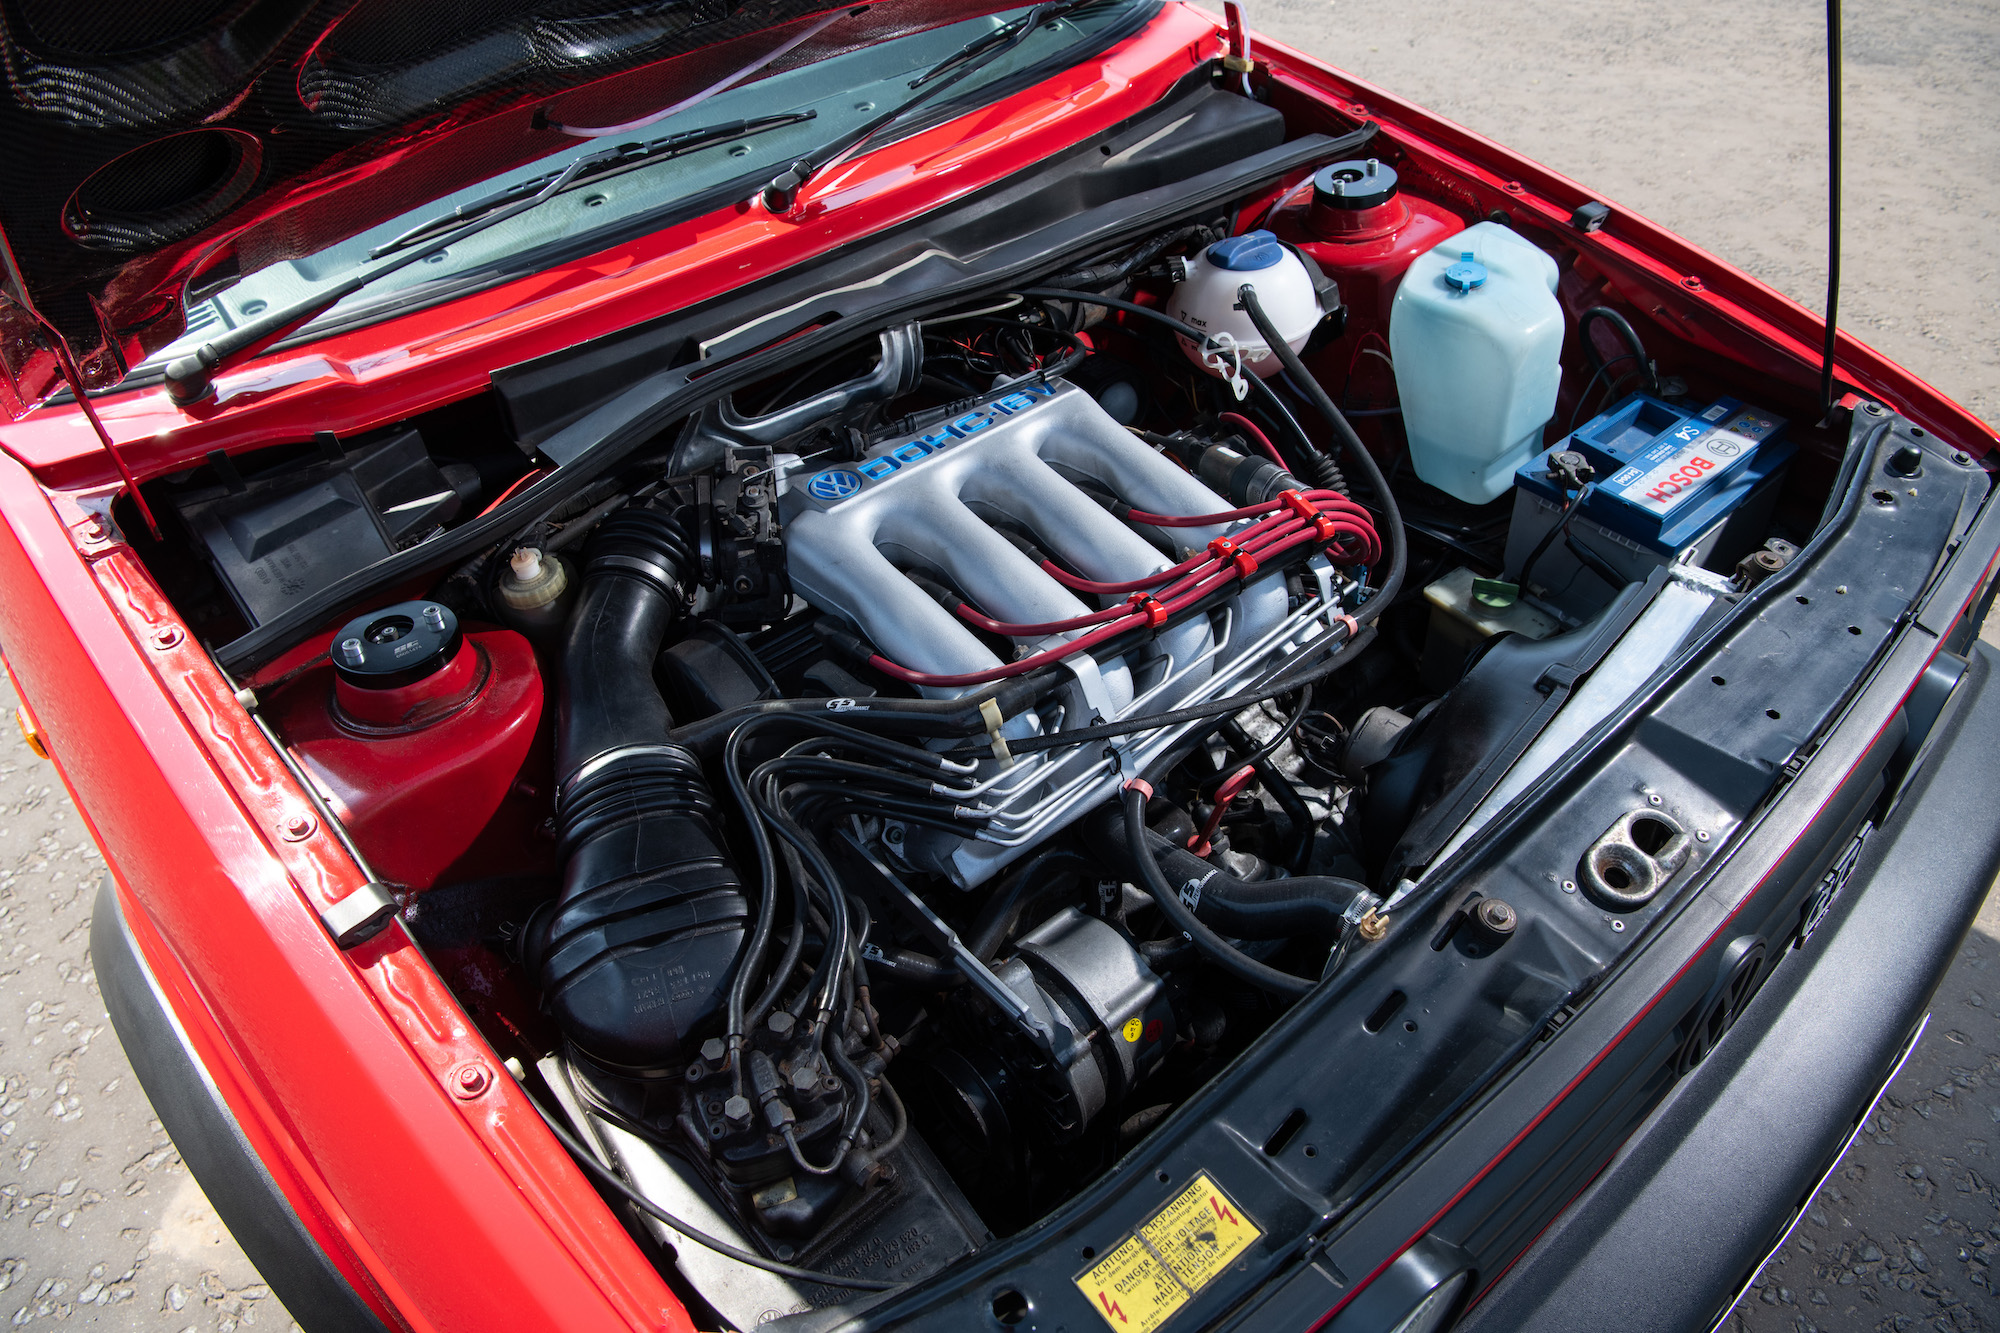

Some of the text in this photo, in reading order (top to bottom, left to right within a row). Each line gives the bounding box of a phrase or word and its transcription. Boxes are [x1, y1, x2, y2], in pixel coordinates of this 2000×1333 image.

[1191, 317, 1207, 327] max
[857, 412, 994, 480] DOHC
[1674, 425, 1700, 442] S4
[1646, 456, 1716, 503] BOSCH
[1093, 1243, 1133, 1279] ACHTUNG
[1115, 1260, 1151, 1292] DANGER
[1153, 1244, 1219, 1304] HAUT TENSION
[1156, 1244, 1203, 1289] ATTNTION!
